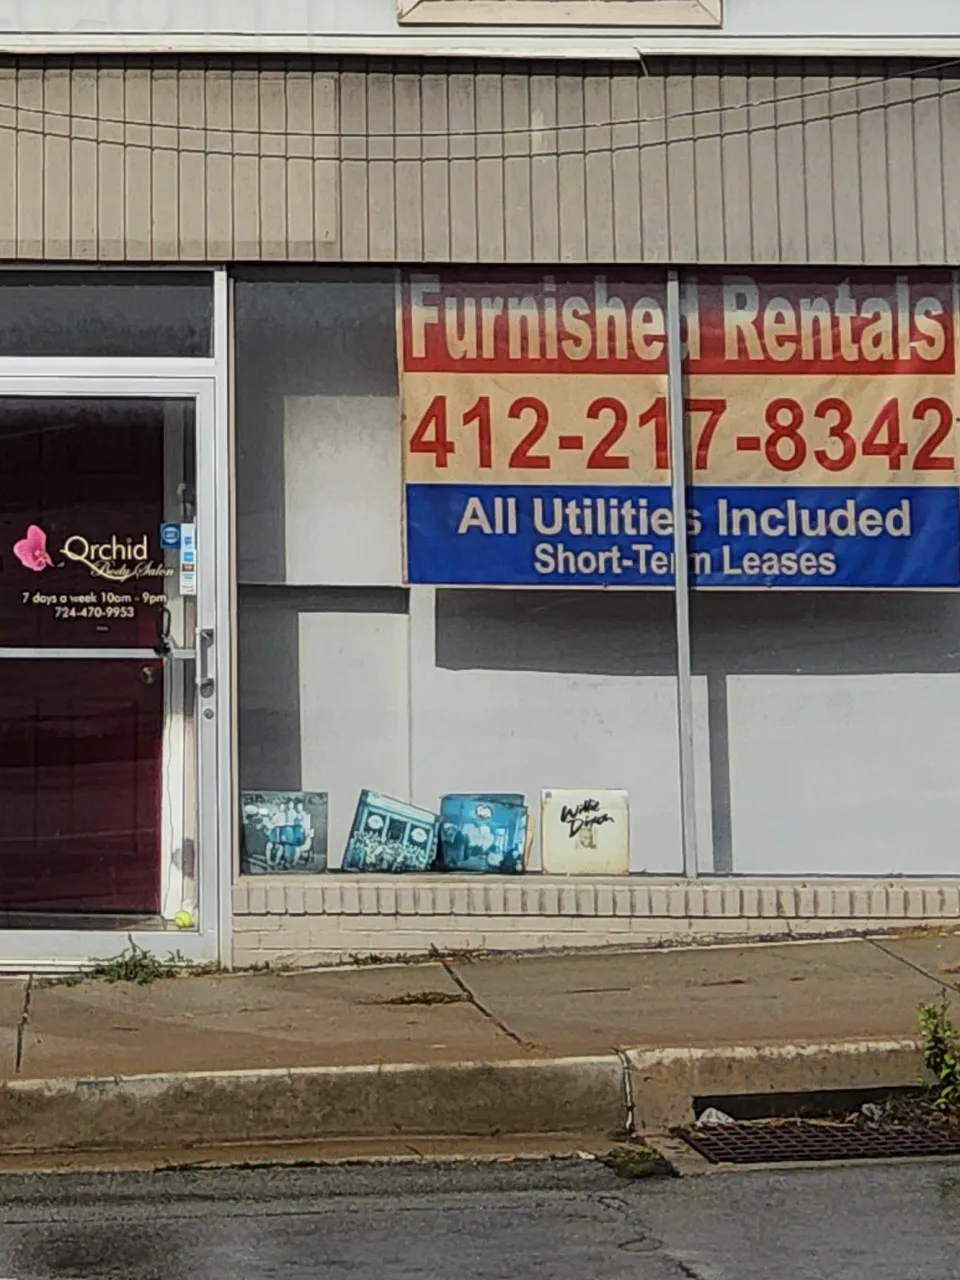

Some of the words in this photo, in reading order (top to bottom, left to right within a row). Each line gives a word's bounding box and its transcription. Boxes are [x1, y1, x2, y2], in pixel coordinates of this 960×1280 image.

[722, 274, 946, 362] Rentals
[409, 395, 956, 472] 412-217-8342
[458, 496, 517, 536] All
[532, 497, 702, 537] Utilities
[717, 498, 912, 538] Included
[60, 534, 148, 561] Orchid
[722, 544, 837, 577] Leases
[22, 591, 30, 604] 7
[32, 591, 57, 606] days
[59, 595, 68, 603] a
[70, 591, 97, 603] week
[101, 591, 132, 603] 10am
[141, 591, 167, 605] 9pm
[54, 606, 135, 618] 724-470-9953
